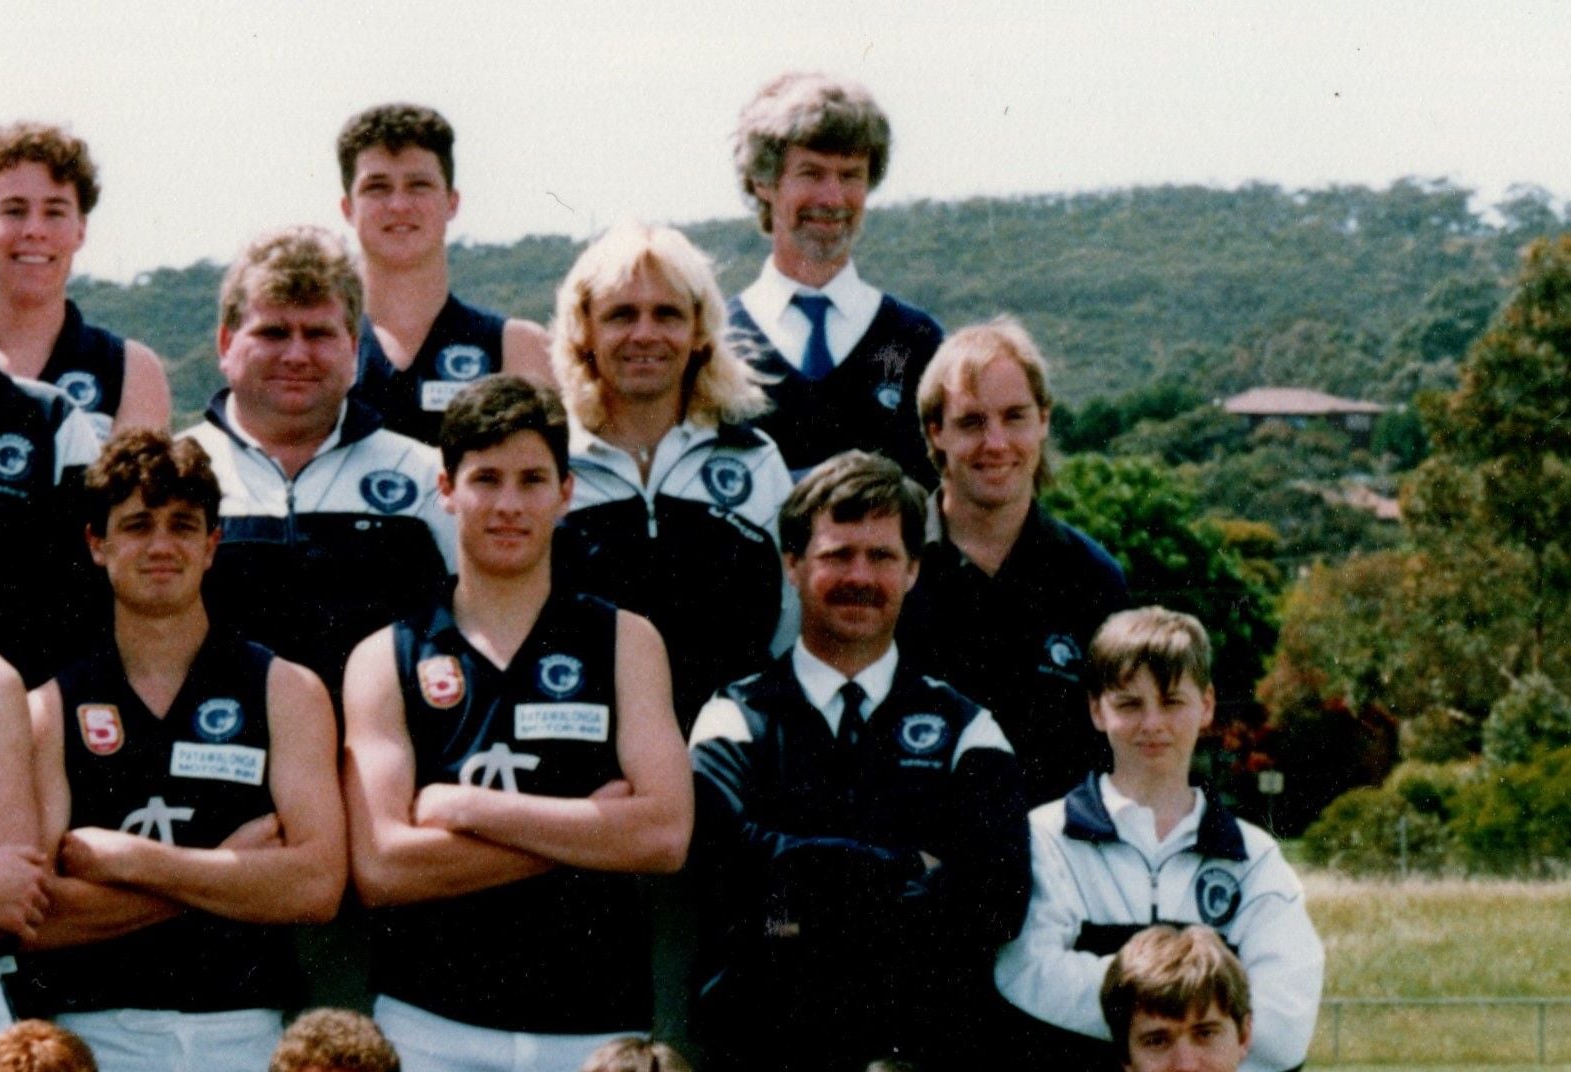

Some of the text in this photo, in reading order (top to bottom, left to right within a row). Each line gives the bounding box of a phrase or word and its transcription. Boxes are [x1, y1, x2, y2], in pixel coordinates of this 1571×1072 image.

[519, 710, 602, 724] PATAWALONGA
[177, 750, 257, 768] PATAWALONGA
[177, 763, 229, 776] MOTOR
